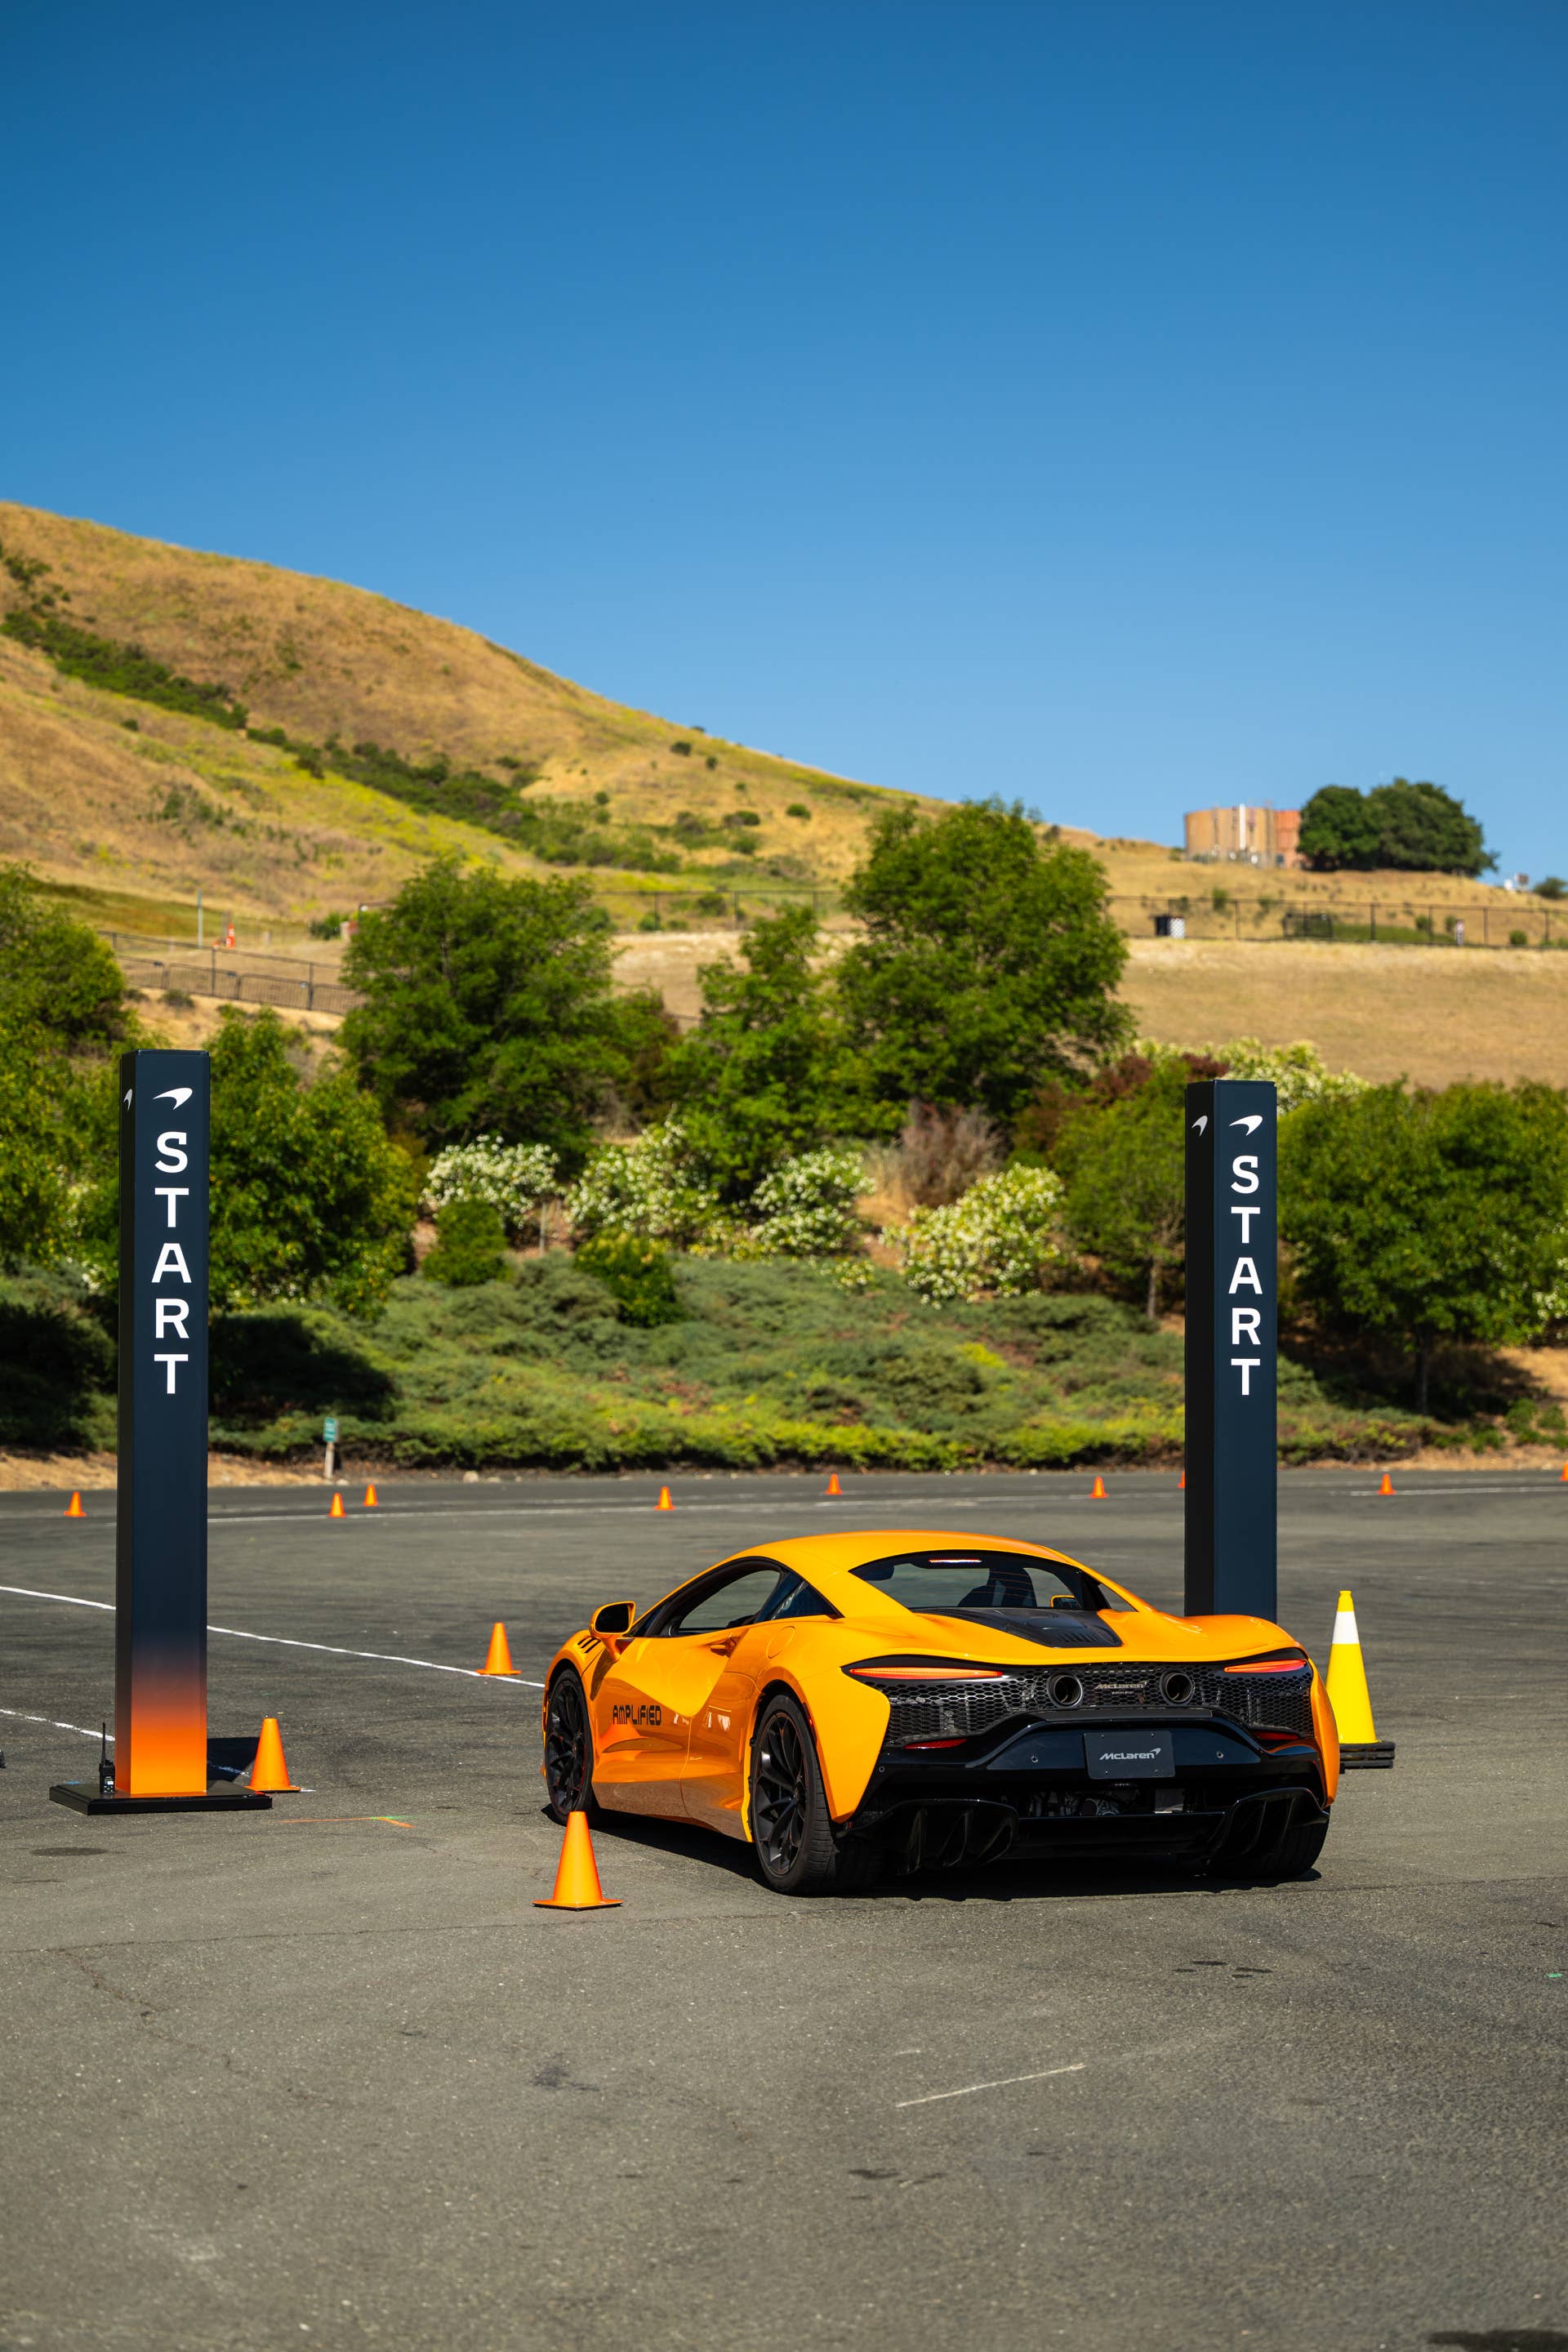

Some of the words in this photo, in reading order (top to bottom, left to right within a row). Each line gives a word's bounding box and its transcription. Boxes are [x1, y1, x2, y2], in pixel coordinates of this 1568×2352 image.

[152, 1131, 192, 1394] START
[1228, 1155, 1263, 1396] START
[612, 1704, 662, 1726] AMPLIFIED
